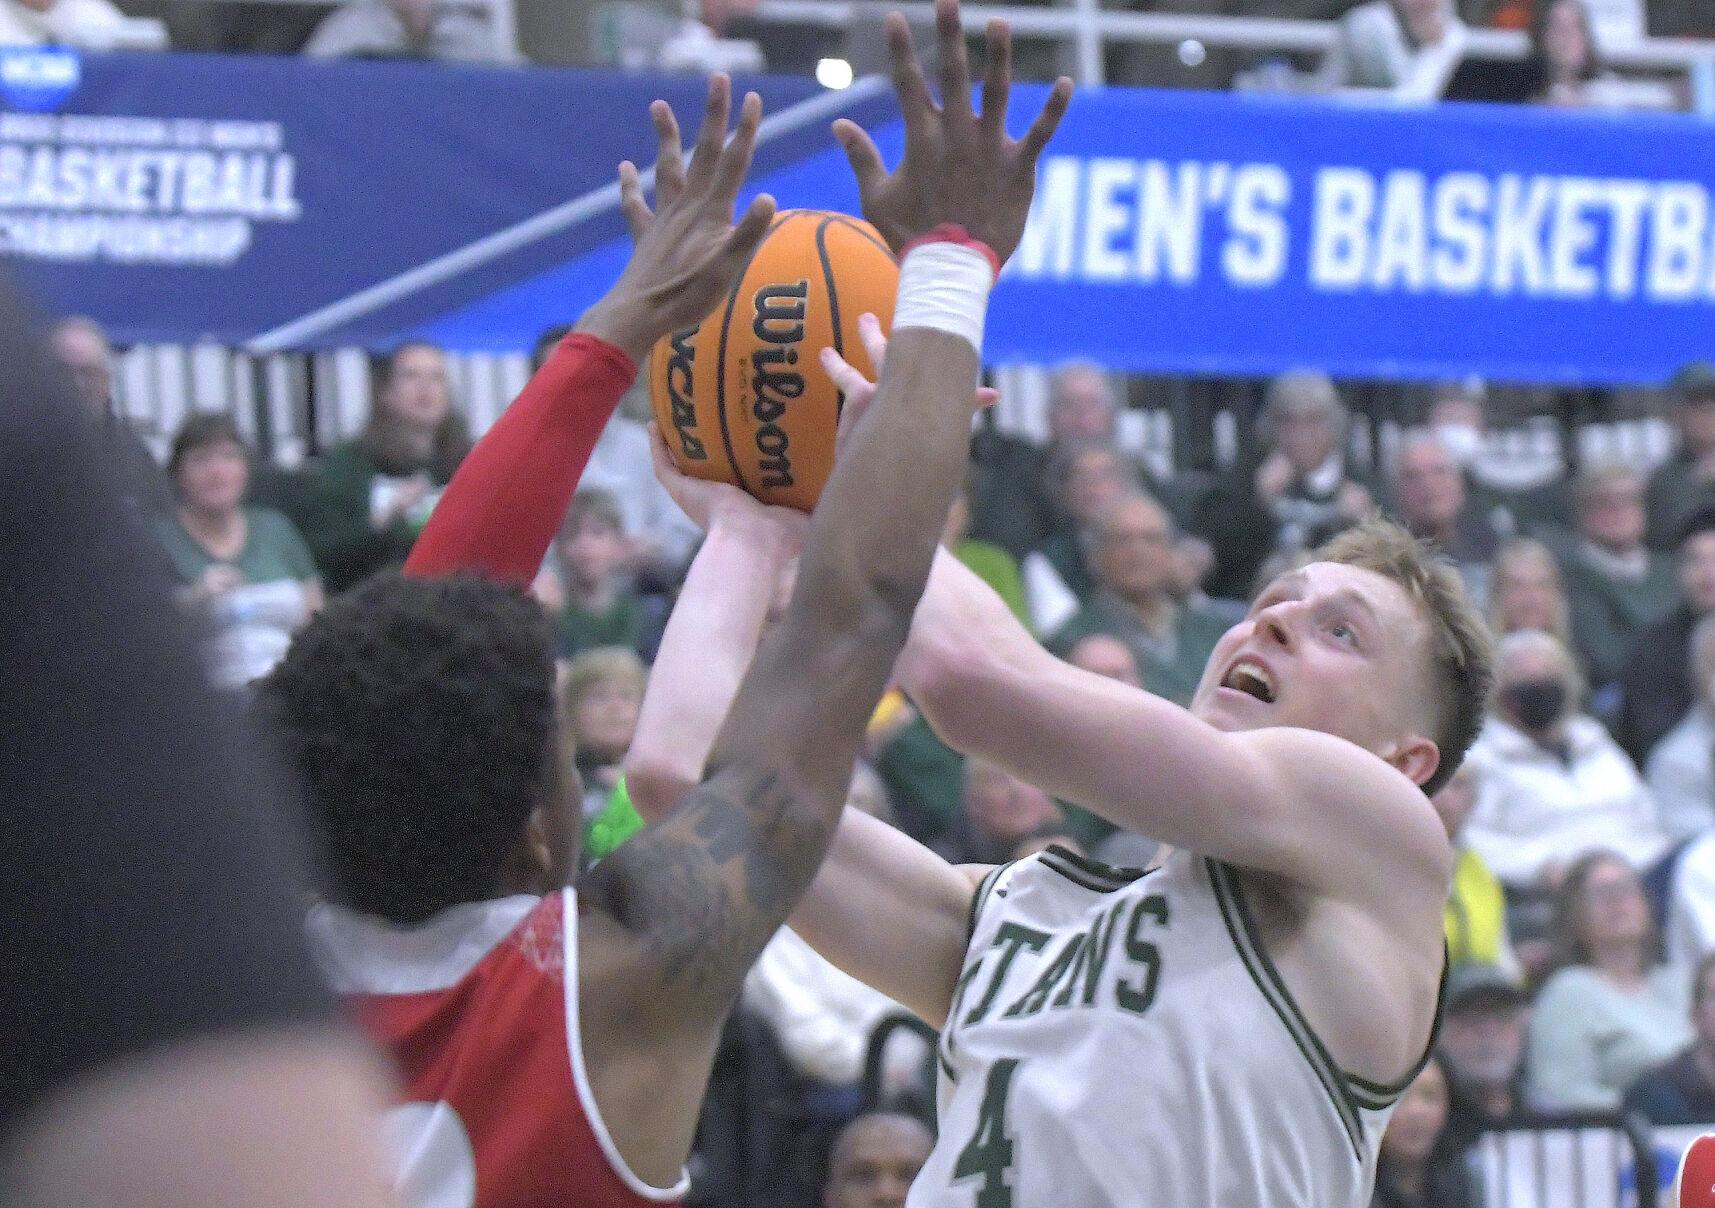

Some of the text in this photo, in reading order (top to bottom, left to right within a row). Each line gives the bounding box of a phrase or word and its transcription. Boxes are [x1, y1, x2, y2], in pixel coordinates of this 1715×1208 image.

[0, 148, 301, 218] BASKETBALL
[1018, 156, 1715, 300] MEN'S BASKETB
[752, 279, 810, 488] Wilson
[950, 1056, 1015, 1208] 4
